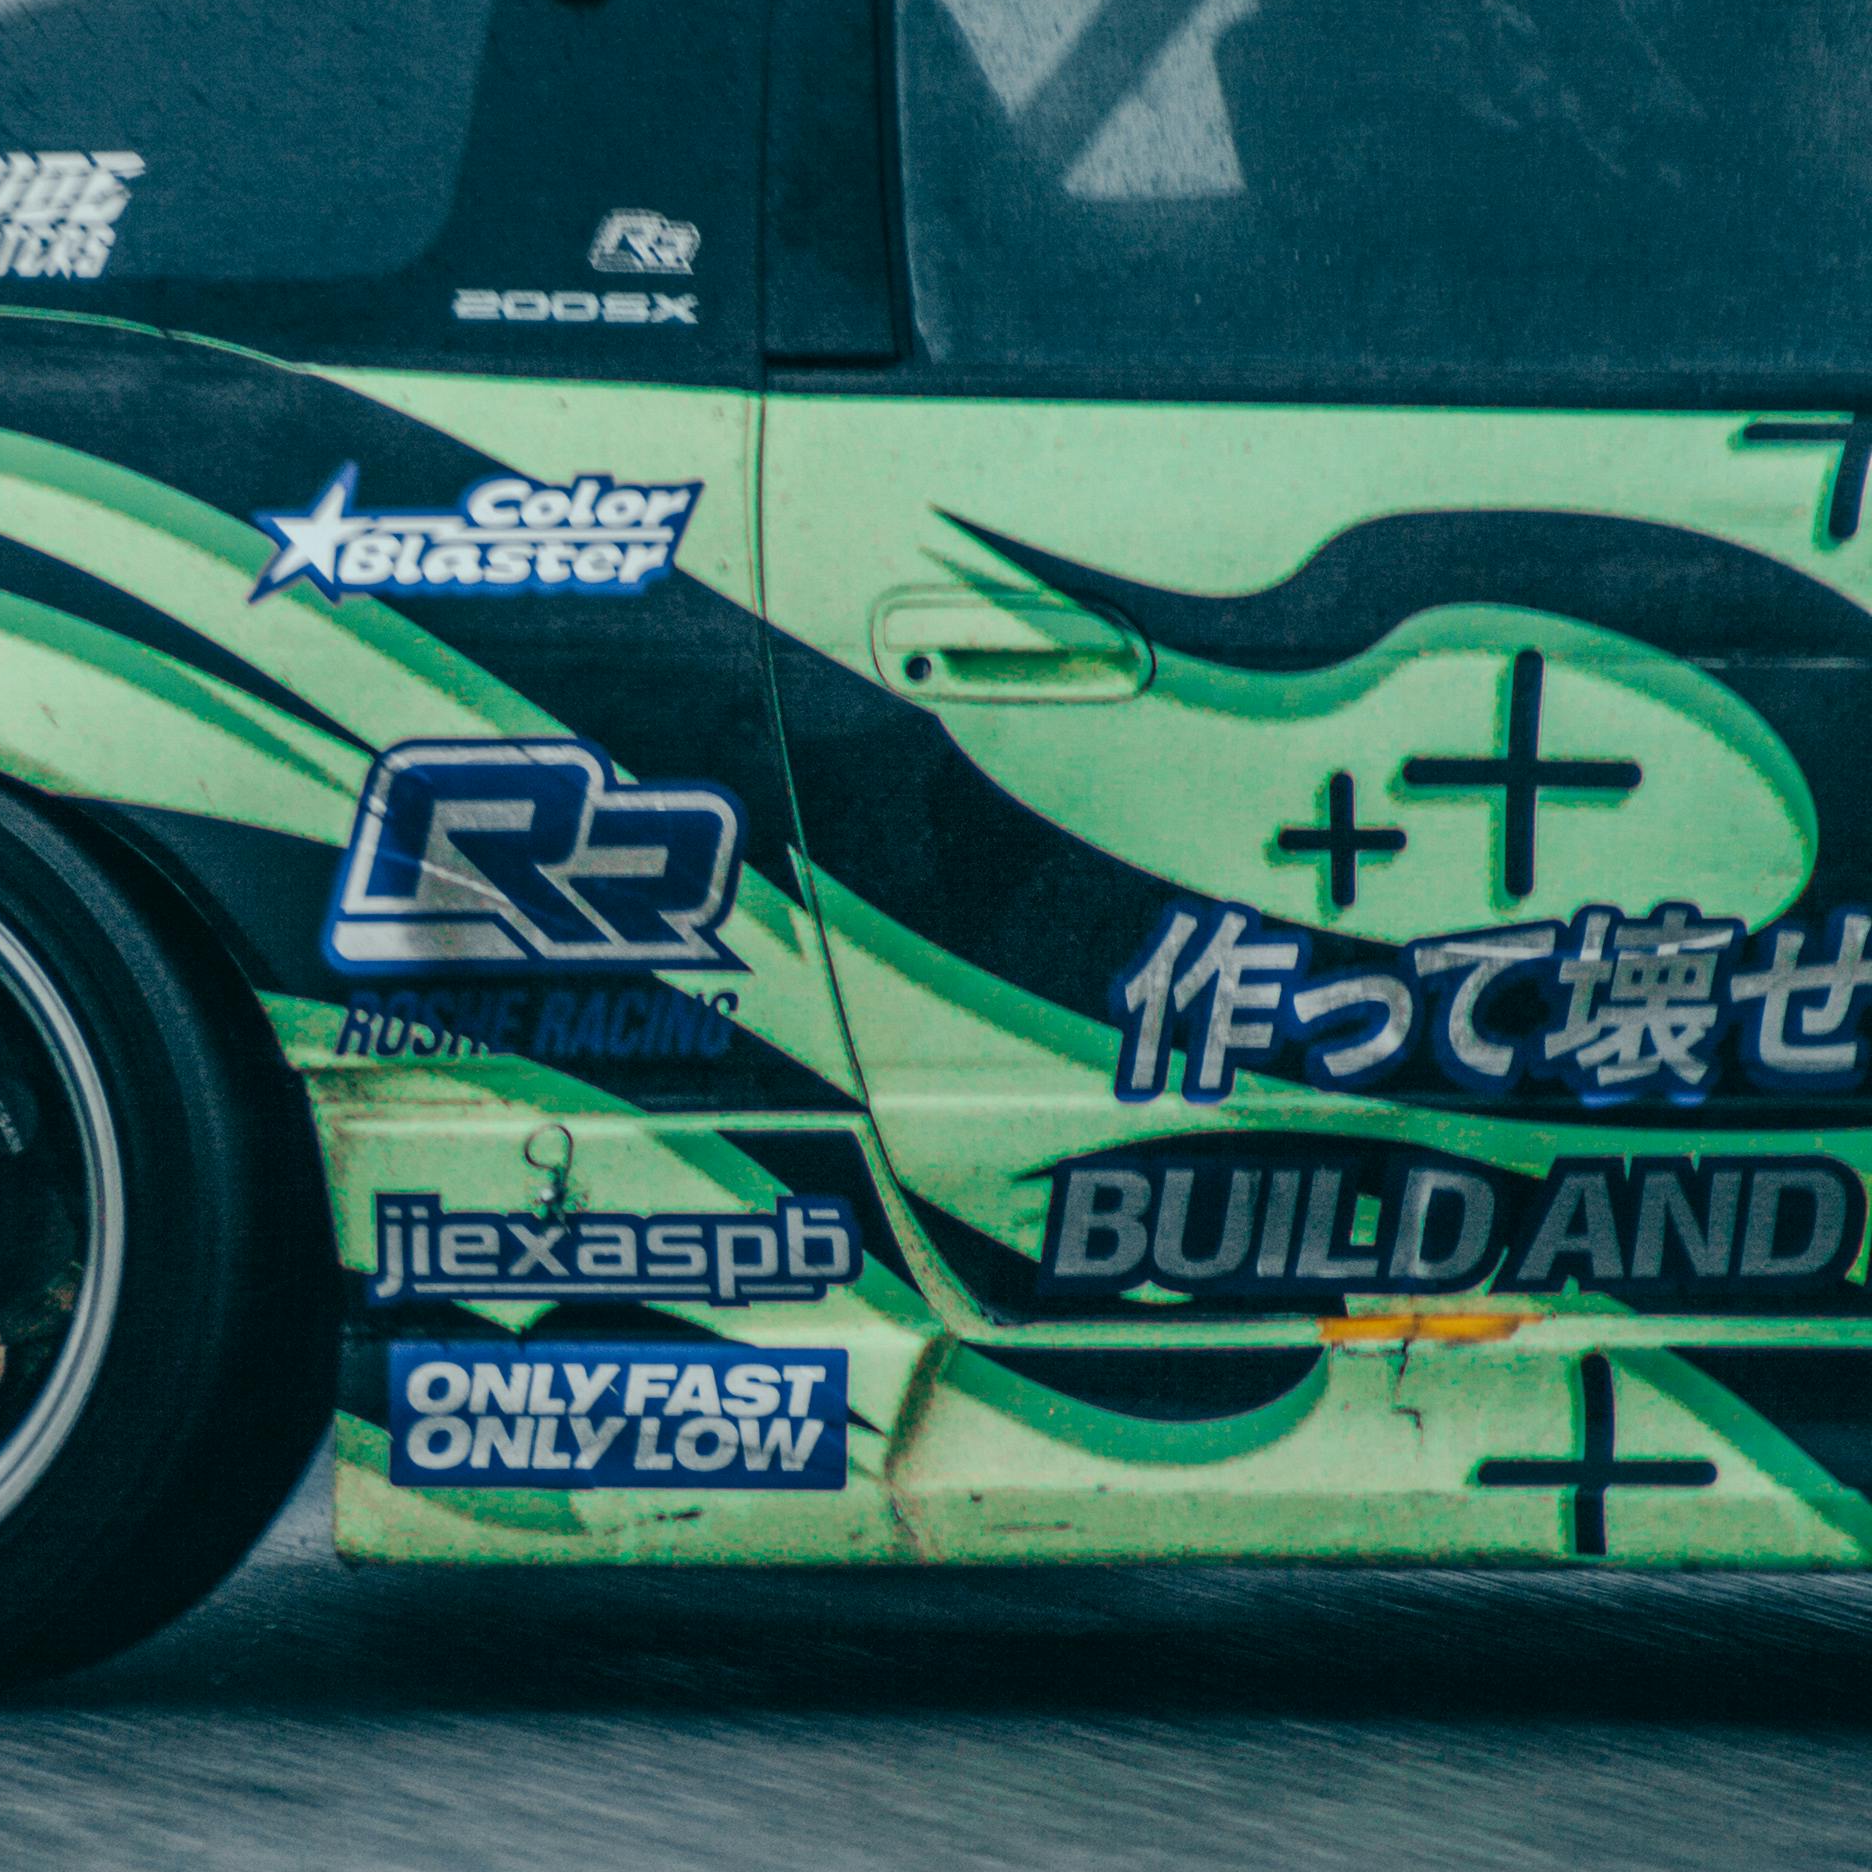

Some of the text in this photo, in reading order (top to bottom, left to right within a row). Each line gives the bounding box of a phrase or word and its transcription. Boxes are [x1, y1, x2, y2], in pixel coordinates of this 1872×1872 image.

[453, 288, 699, 324] 200SX
[467, 479, 691, 528] Color
[338, 534, 669, 584] Blaster
[336, 991, 739, 1058] ROSHE RACING
[1126, 911, 1872, 1090] 作って壊せ
[1054, 1168, 1847, 1279] BUILD AND
[407, 1363, 826, 1416] ONLY FAST
[407, 1416, 826, 1471] ONLY LOW
